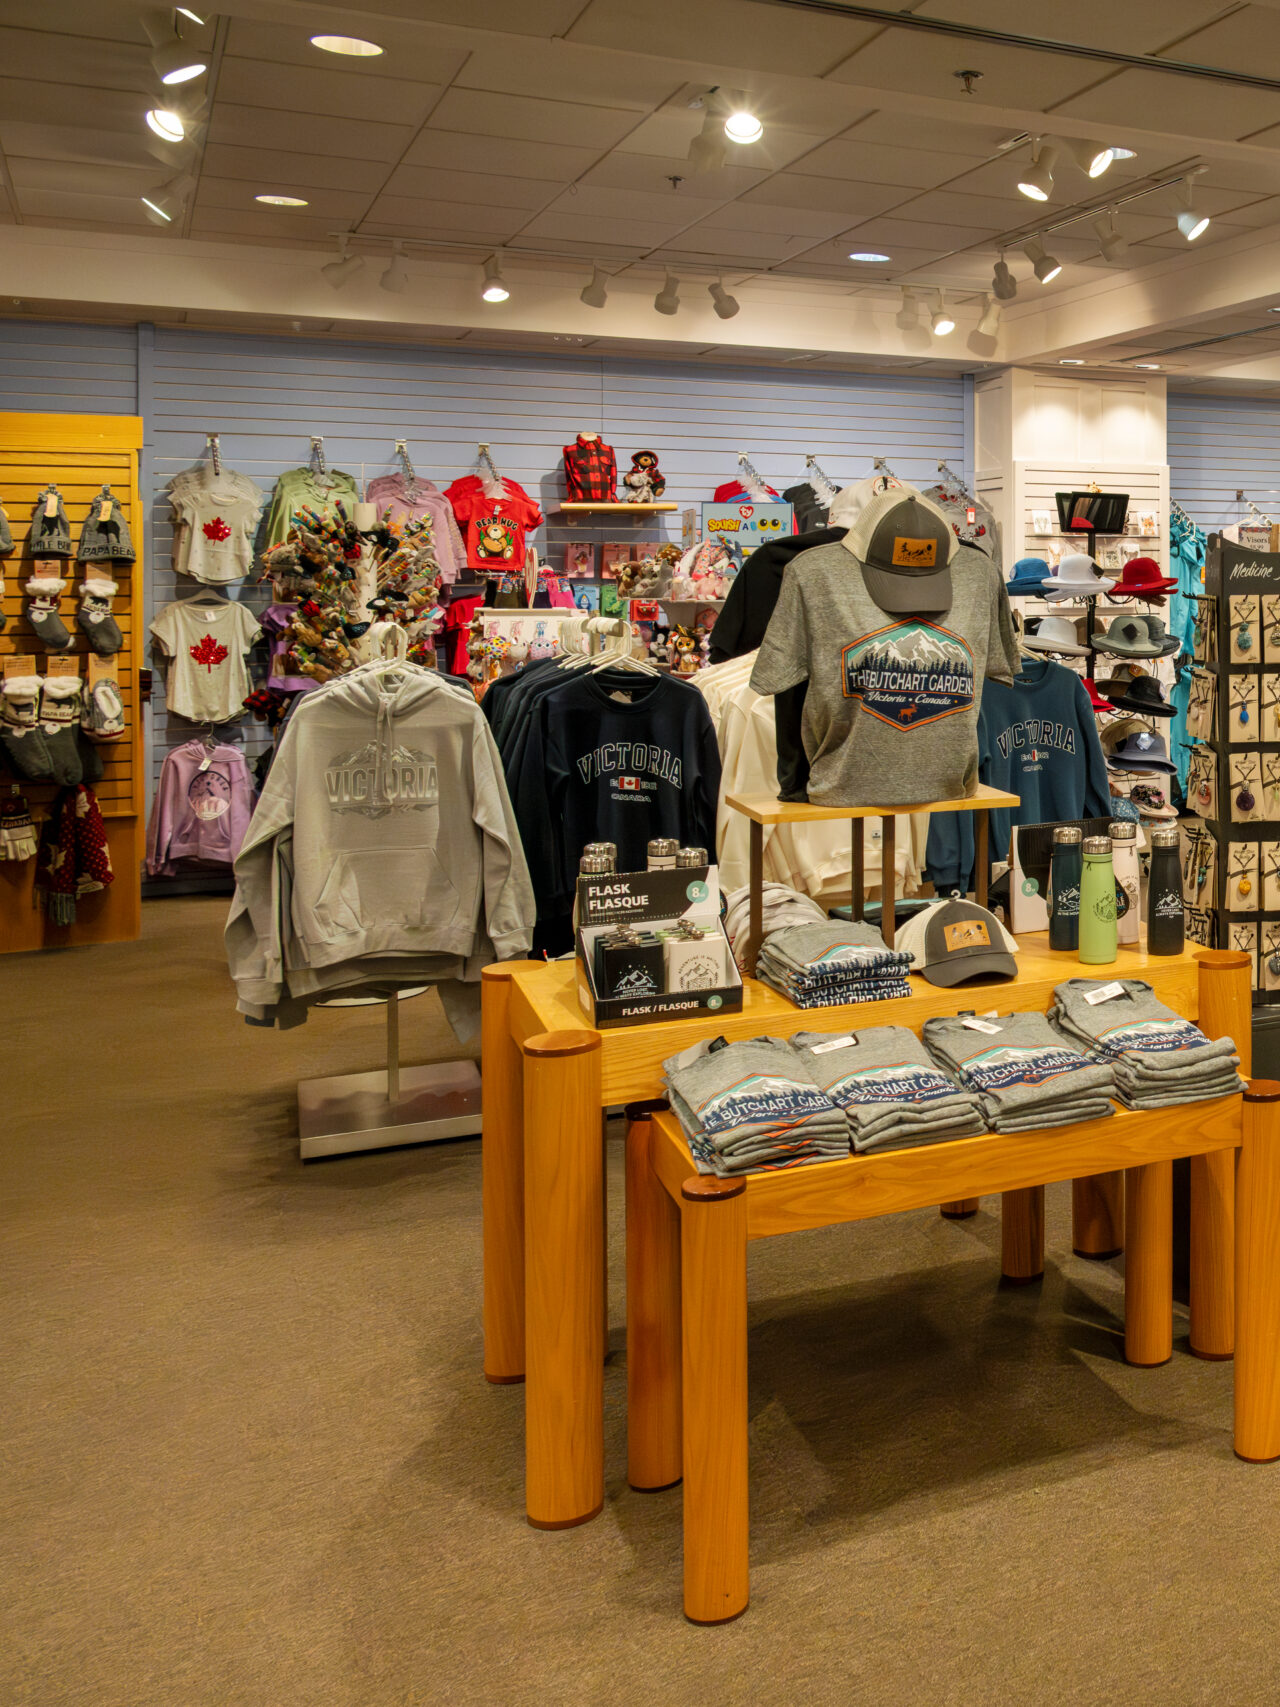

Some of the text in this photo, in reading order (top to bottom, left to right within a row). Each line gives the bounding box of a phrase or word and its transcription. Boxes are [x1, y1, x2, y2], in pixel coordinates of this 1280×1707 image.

[740, 506, 752, 517] ty
[475, 516, 518, 531] BEAR HUG
[708, 519, 741, 532] SQUISH
[742, 523, 749, 531] A
[1246, 536, 1270, 544] Visors
[82, 546, 110, 557] PAPA
[1229, 561, 1274, 581] Medicine
[868, 670, 928, 692] BUTCHART
[867, 691, 952, 705] Victoria Canada
[577, 742, 682, 790] VICTORIA
[324, 765, 439, 803] VICTORIA
[588, 883, 699, 898] FLASK 8
[589, 895, 650, 911] FLASQUE
[622, 1004, 652, 1016] FLASK
[658, 1000, 700, 1012] FLASQUE
[1032, 1065, 1073, 1076] Canada
[720, 1095, 796, 1121] BUTCHART
